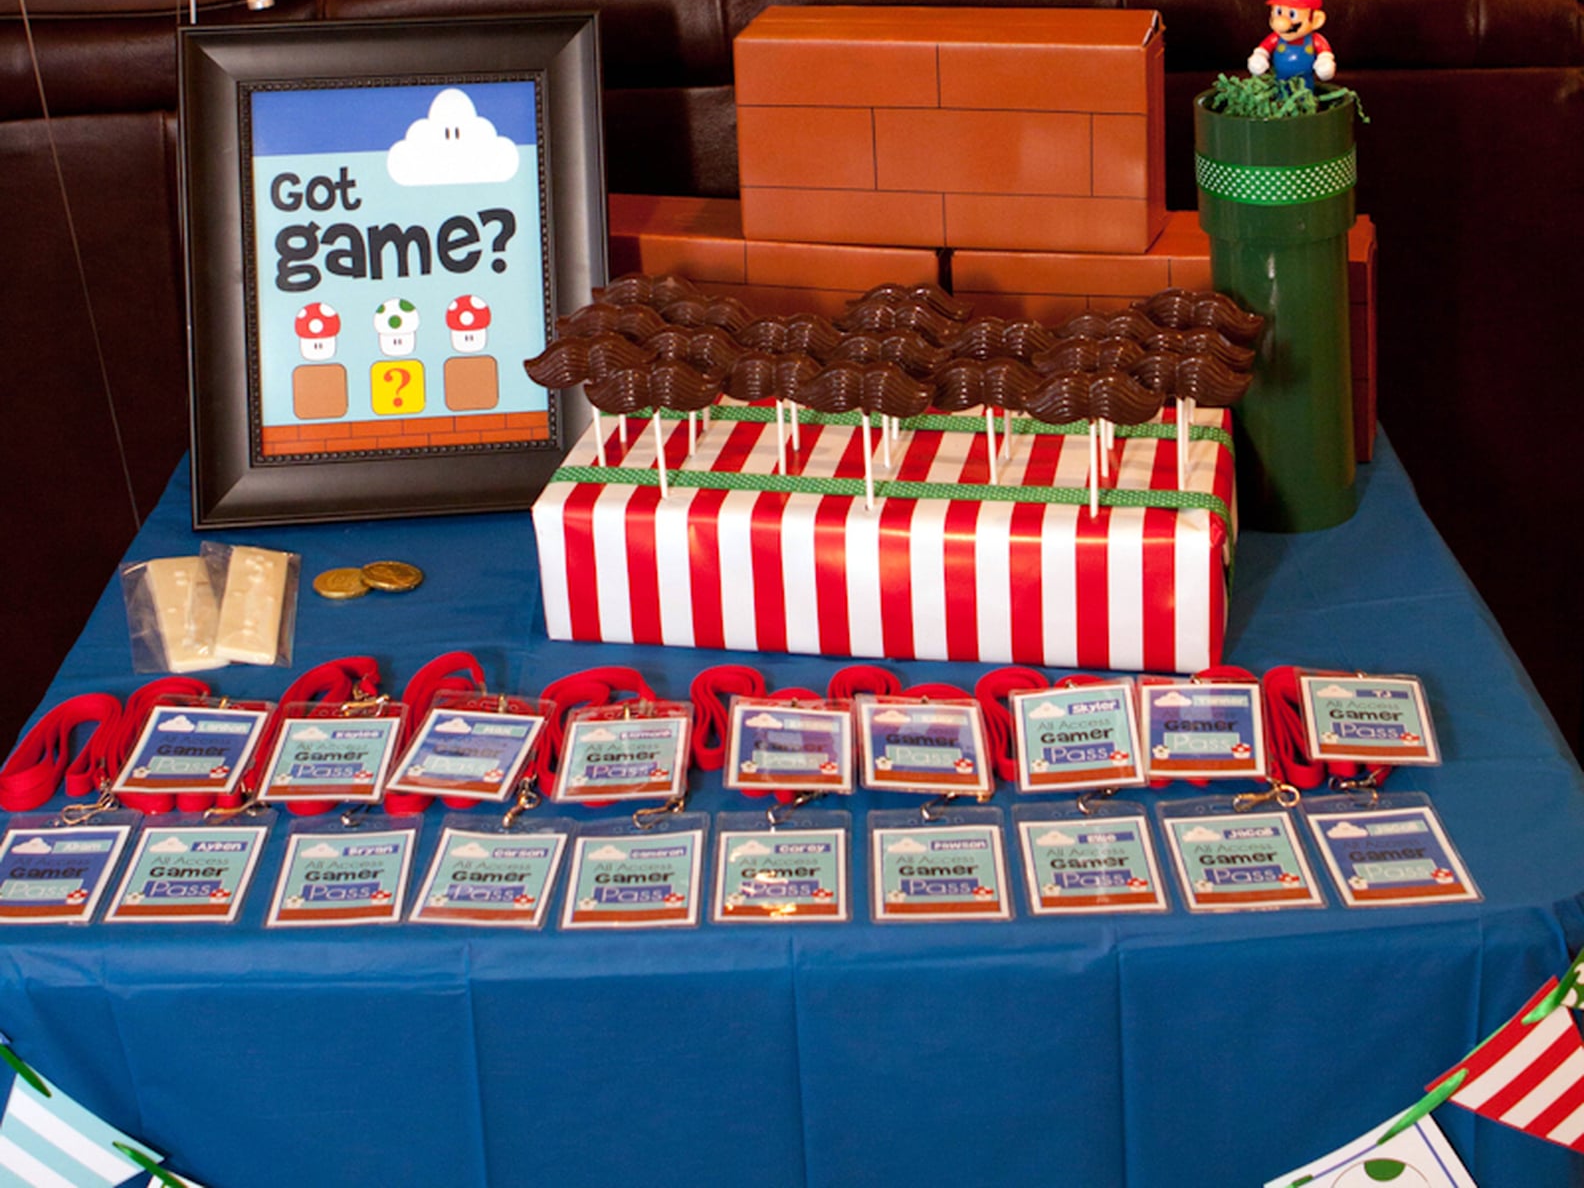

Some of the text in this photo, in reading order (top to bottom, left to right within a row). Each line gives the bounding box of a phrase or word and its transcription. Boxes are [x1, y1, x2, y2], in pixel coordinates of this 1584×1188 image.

[271, 167, 362, 212] Got
[275, 208, 517, 293] game?
[383, 367, 411, 407] ?
[1072, 701, 1116, 714] Skyler
[1327, 700, 1342, 708] All
[1329, 709, 1403, 721] Gamer
[1037, 718, 1111, 731] All Access
[1164, 720, 1238, 731] Gamer
[1341, 723, 1398, 739] Pass
[886, 734, 958, 746] Gamer
[1041, 728, 1114, 744] Gamer
[156, 744, 231, 755] Gamer
[1173, 735, 1231, 752] Pass
[294, 752, 368, 761] Gamer
[587, 752, 661, 762] Gamer
[1051, 747, 1107, 763] Pass
[296, 764, 354, 778] Pass
[1047, 848, 1064, 856] All
[1194, 844, 1212, 853] All
[1350, 847, 1426, 862] Gamer
[152, 856, 229, 865] All Access
[305, 861, 322, 869] All
[739, 858, 756, 866] All
[896, 856, 914, 864] All
[1050, 856, 1128, 869] Gamer
[1199, 852, 1278, 865] Gamer
[10, 867, 88, 878] Gamer
[150, 866, 229, 877] Gamer
[594, 863, 612, 871] All
[899, 864, 978, 876] Gamer
[1366, 864, 1429, 882] Pass
[305, 870, 384, 881] Gamer
[452, 871, 531, 882] Gamer
[595, 872, 675, 884] Gamer
[1063, 872, 1124, 888] Pass
[1214, 868, 1276, 884] Pass
[8, 881, 69, 897] Pass
[151, 882, 211, 896] Pass
[309, 885, 370, 900] Pass
[453, 886, 514, 901] Pass
[910, 880, 971, 894] Pass
[602, 887, 662, 902] Pass
